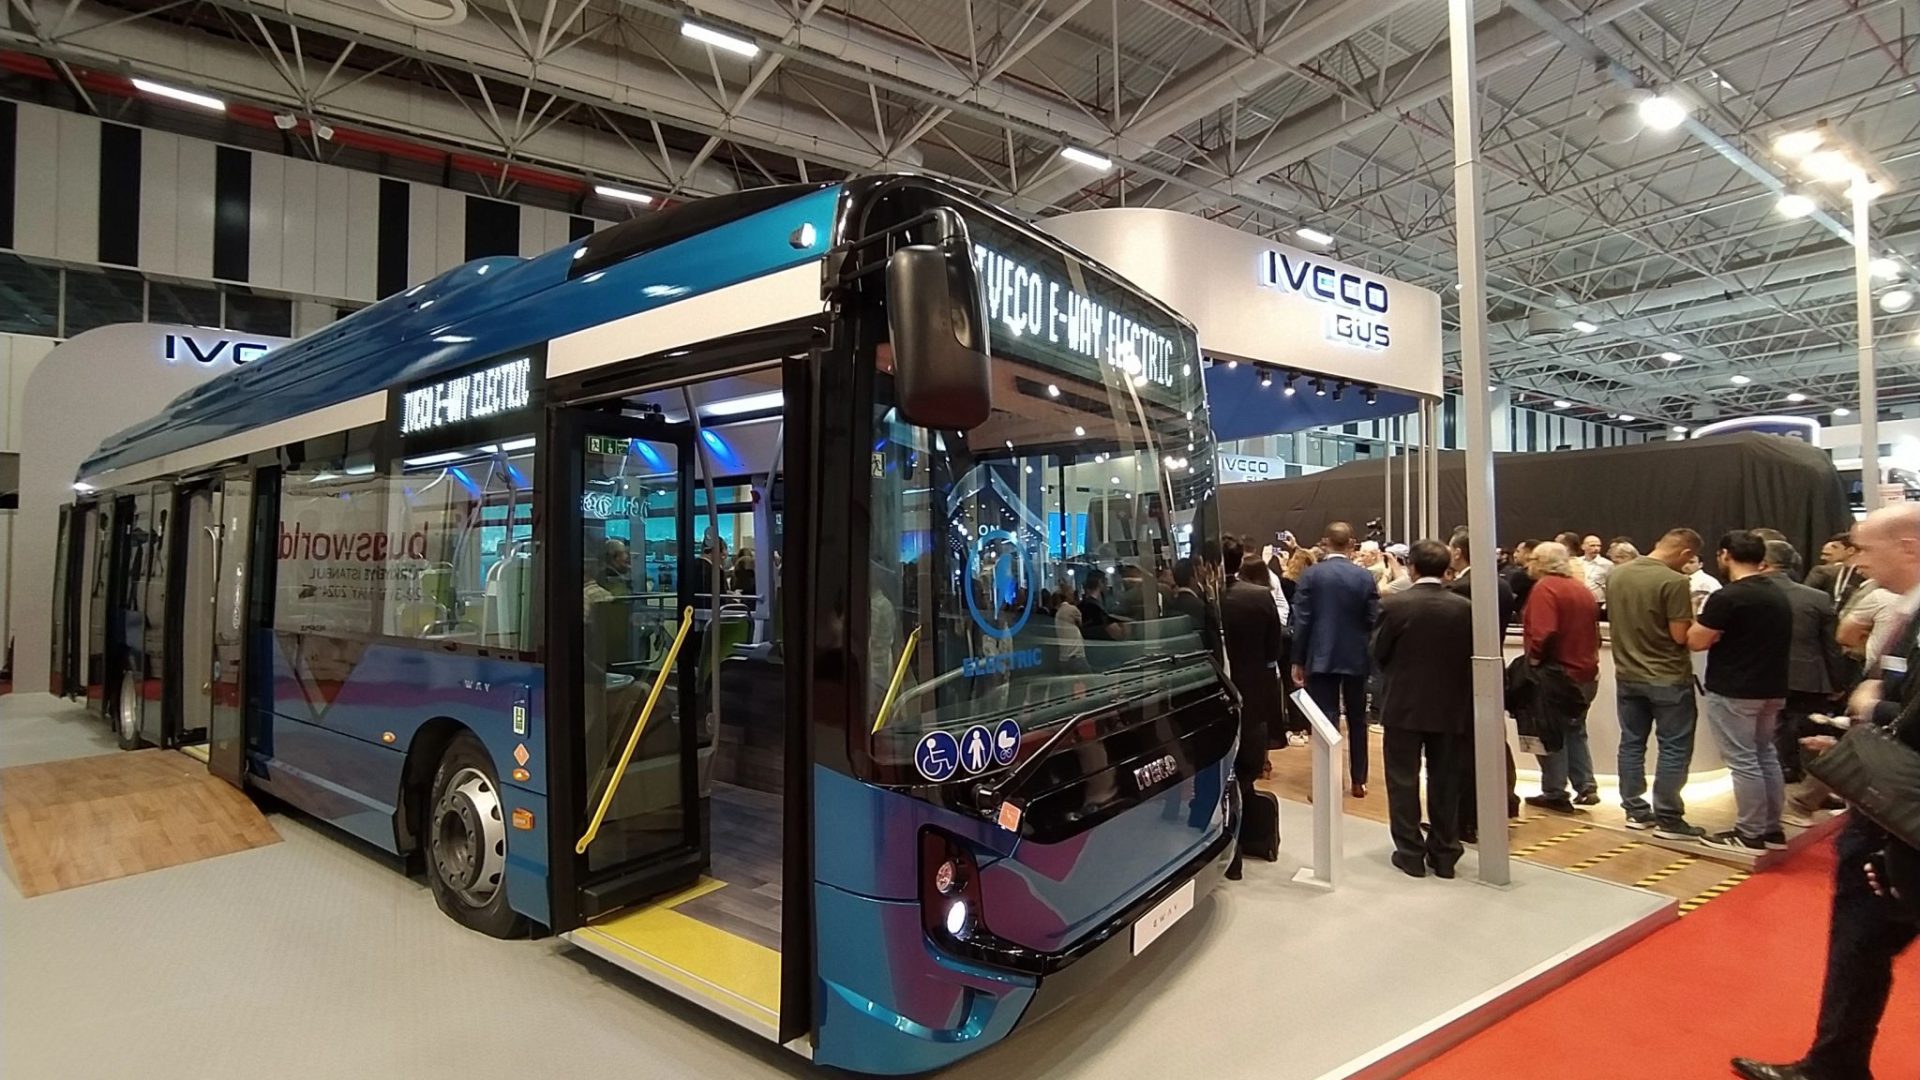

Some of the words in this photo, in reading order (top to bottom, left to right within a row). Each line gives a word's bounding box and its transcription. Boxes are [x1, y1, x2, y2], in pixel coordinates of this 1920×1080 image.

[1268, 249, 1389, 314] IVECO
[1049, 281, 1103, 360] E-WAY
[1336, 313, 1390, 348] BUS
[1221, 457, 1269, 474] IVECO
[963, 648, 1042, 678] ELECTRIC
